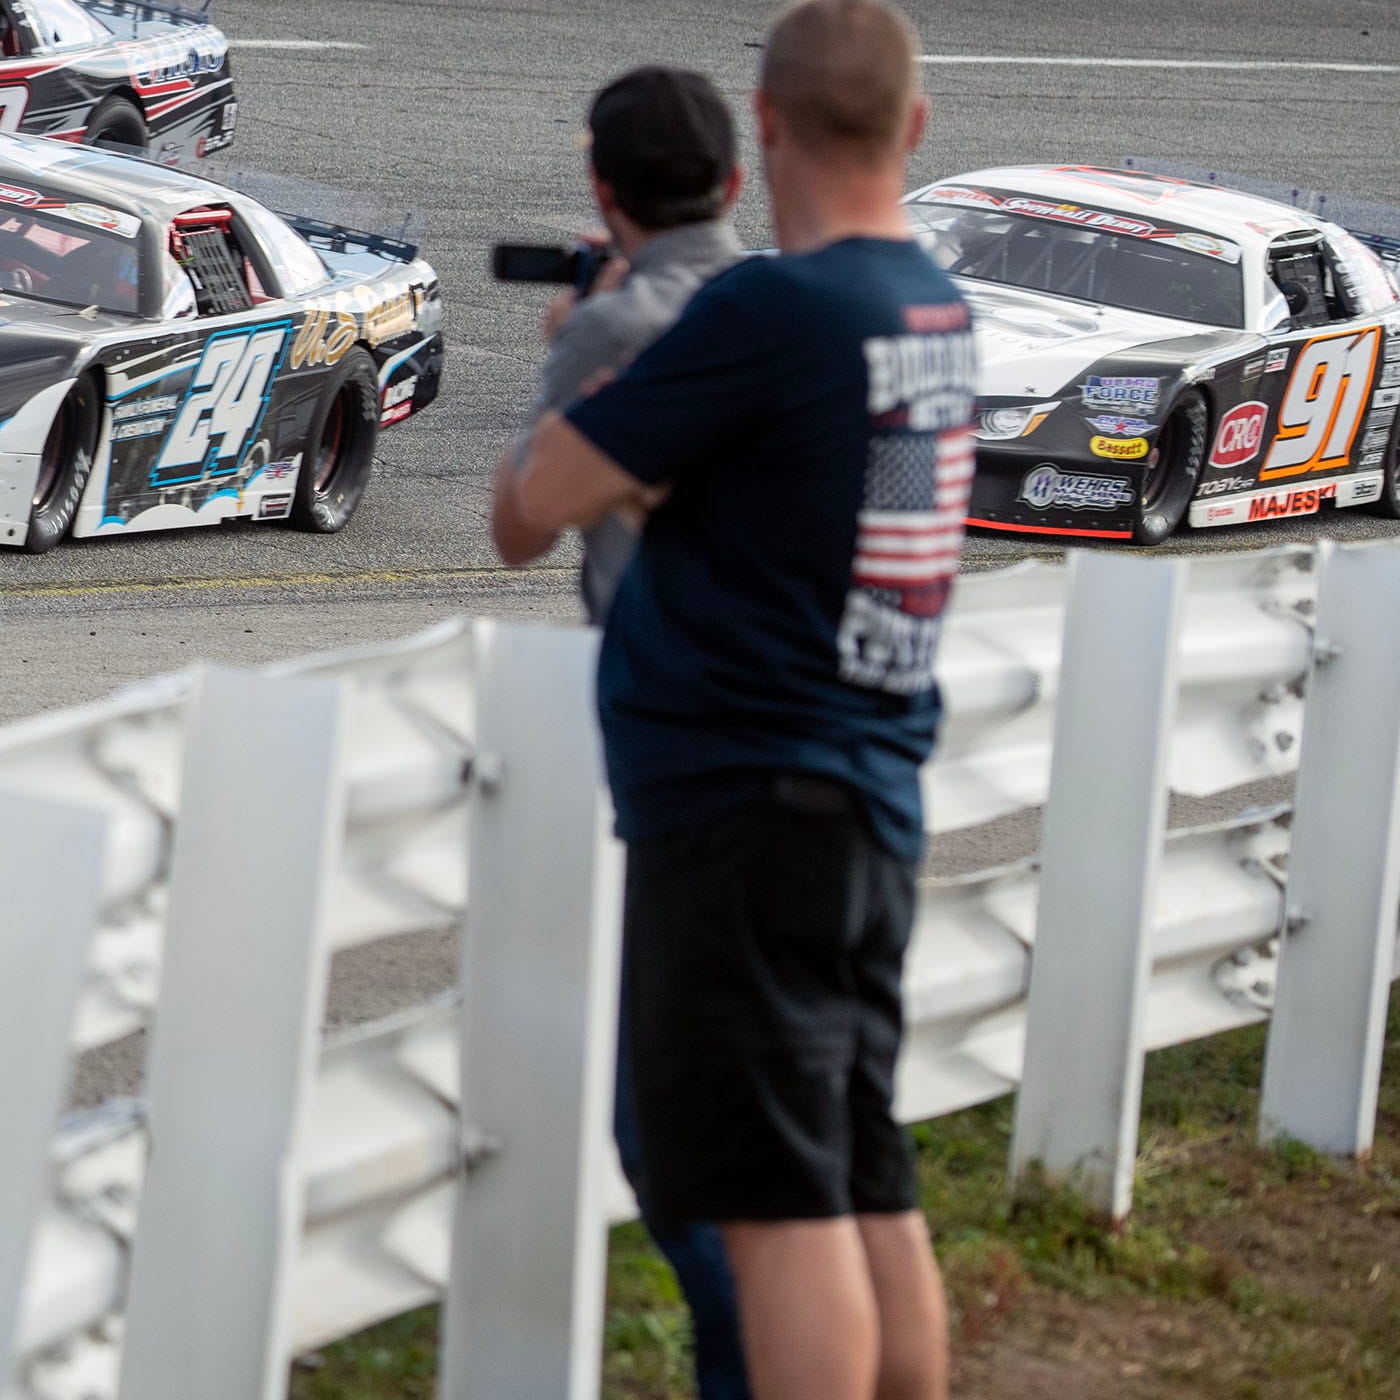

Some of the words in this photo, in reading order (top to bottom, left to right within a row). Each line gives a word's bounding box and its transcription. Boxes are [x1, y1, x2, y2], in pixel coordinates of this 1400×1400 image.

[156, 325, 286, 469] 24
[1085, 386, 1157, 402] FORCE
[1262, 330, 1378, 472] 91
[1096, 439, 1143, 456] Bassett
[1059, 475, 1128, 493] WEHRS
[1051, 487, 1133, 502] MACHINE
[1247, 482, 1338, 521] MAJESKI
